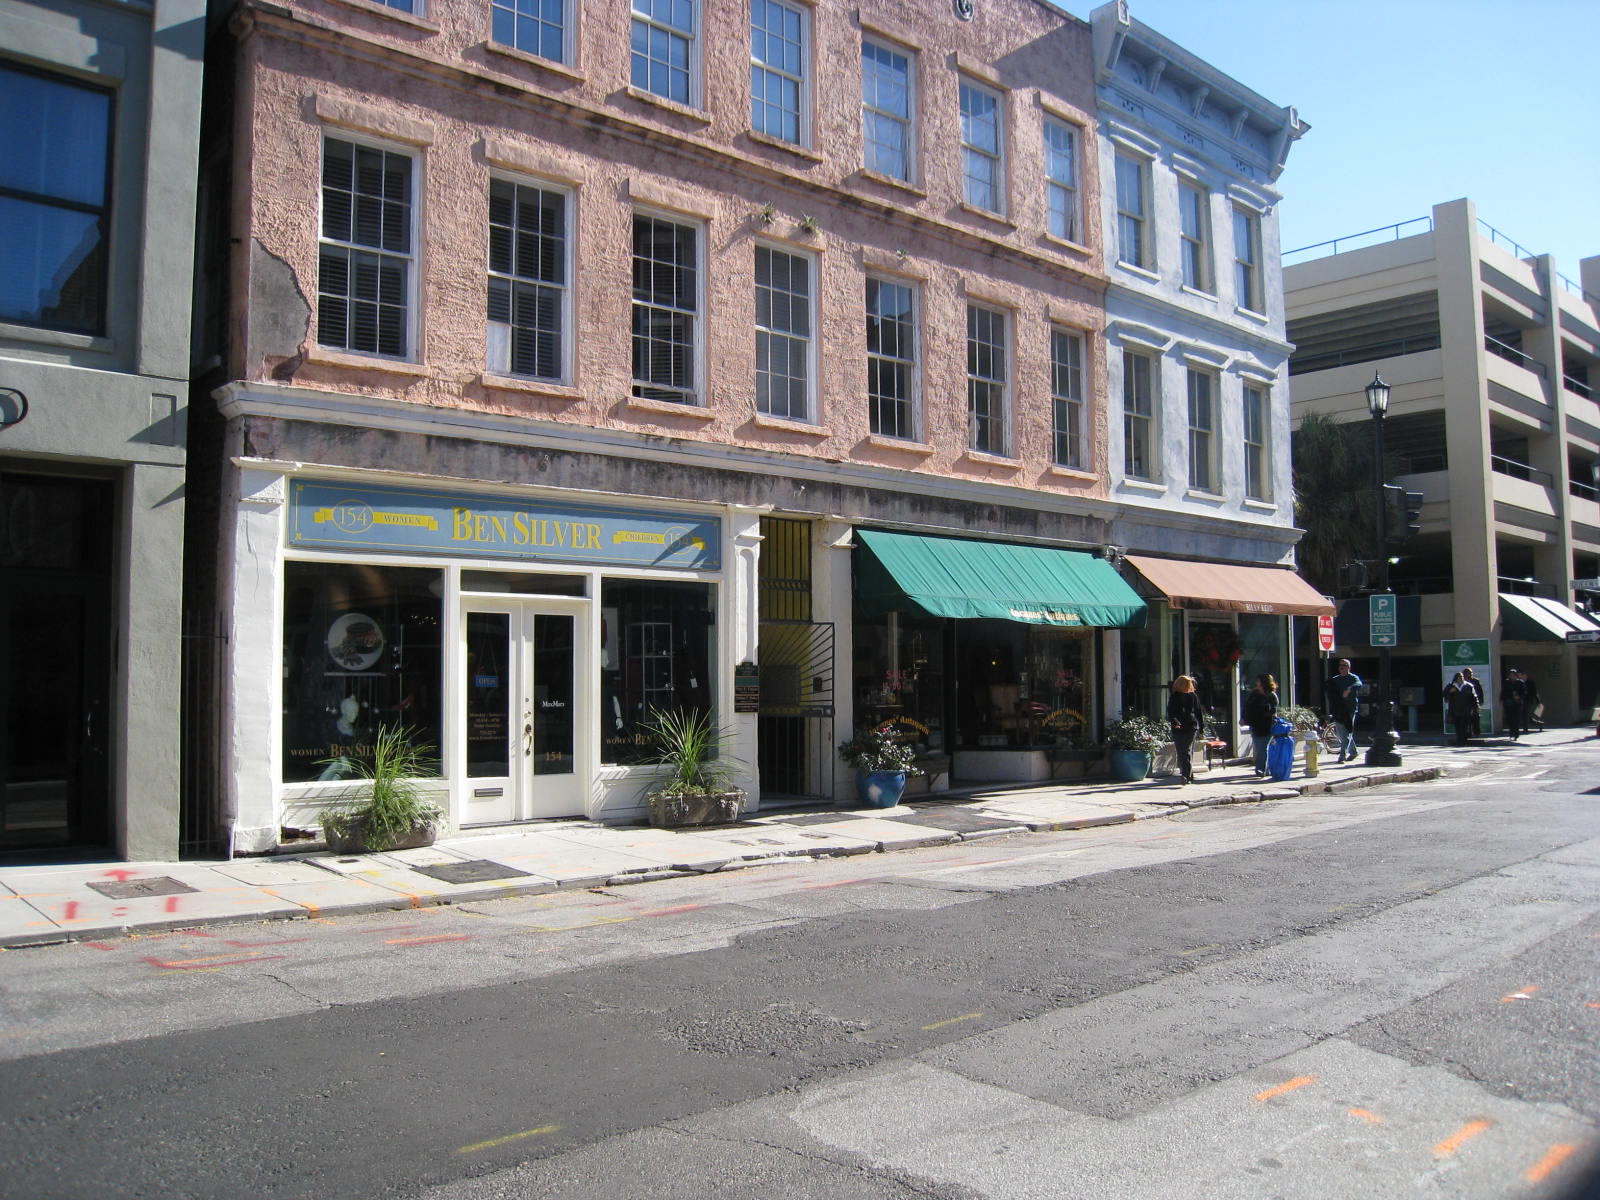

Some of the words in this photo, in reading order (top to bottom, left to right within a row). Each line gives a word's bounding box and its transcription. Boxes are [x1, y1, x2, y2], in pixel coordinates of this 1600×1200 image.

[339, 507, 367, 527] 154
[384, 514, 421, 525] WOMEN
[452, 506, 507, 543] BEN
[512, 511, 603, 549] SILVER
[625, 533, 660, 543] CHILDREN
[1378, 599, 1389, 610] P
[546, 752, 562, 761] 154
